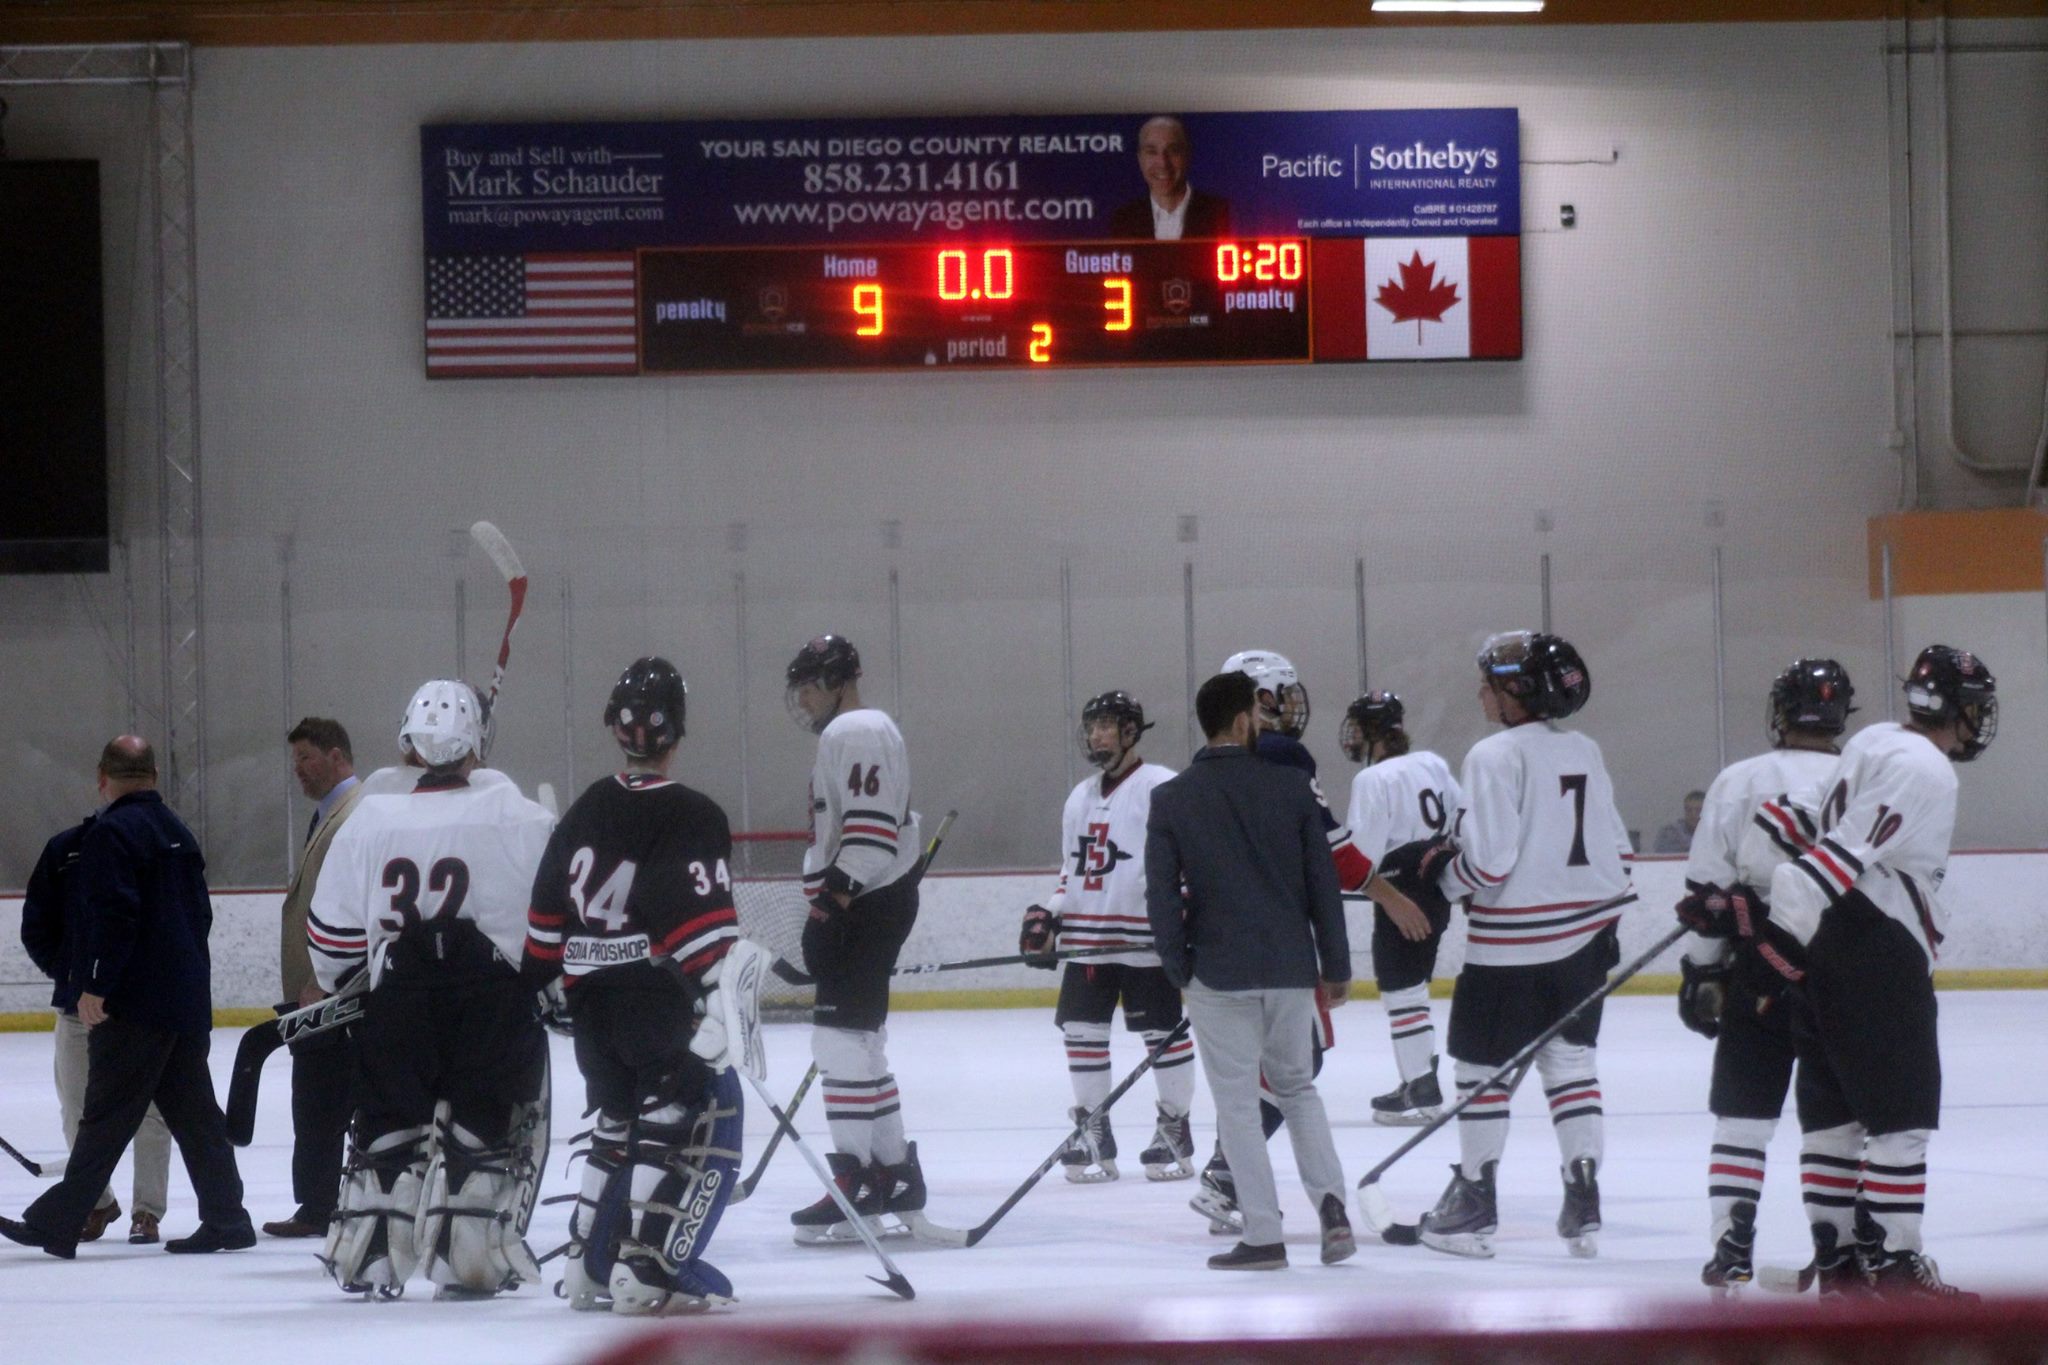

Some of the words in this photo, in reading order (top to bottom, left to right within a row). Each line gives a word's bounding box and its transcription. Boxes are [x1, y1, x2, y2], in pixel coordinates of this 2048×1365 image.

[446, 149, 482, 174] Buy
[489, 148, 522, 166] and
[529, 147, 565, 165] Sell
[571, 147, 612, 165] with
[700, 140, 766, 158] YOUR
[773, 139, 820, 157] SAN
[828, 138, 902, 156] DIEGO
[909, 137, 1012, 155] COUNTY
[1019, 135, 1124, 153] REALTOR
[1369, 142, 1498, 175] Sotheby's
[448, 170, 523, 197] Mark
[532, 167, 663, 195] Schauder
[804, 160, 1019, 193] 858.231.4161
[1262, 154, 1343, 178] Pacific
[1370, 179, 1456, 190] INTERNATIONAL
[1459, 178, 1497, 189] REALTY
[449, 205, 664, 228] mark@powayagent.com
[734, 197, 1093, 232] www.powayagent.com
[1442, 217, 1458, 226] and
[823, 255, 878, 278] Home
[937, 248, 1013, 300] 0.0
[1065, 250, 1133, 274] Guests
[1216, 243, 1302, 281] 0:20
[656, 298, 726, 324] penalty
[853, 284, 883, 336] 9
[1102, 278, 1132, 331] 3
[1225, 288, 1295, 313] penalty
[947, 335, 1008, 363] period
[1030, 323, 1052, 362] 2
[847, 763, 881, 798] 46
[1558, 773, 1591, 868] 7
[1864, 803, 1904, 850] 10
[688, 858, 731, 897] 34
[378, 857, 470, 932] 32
